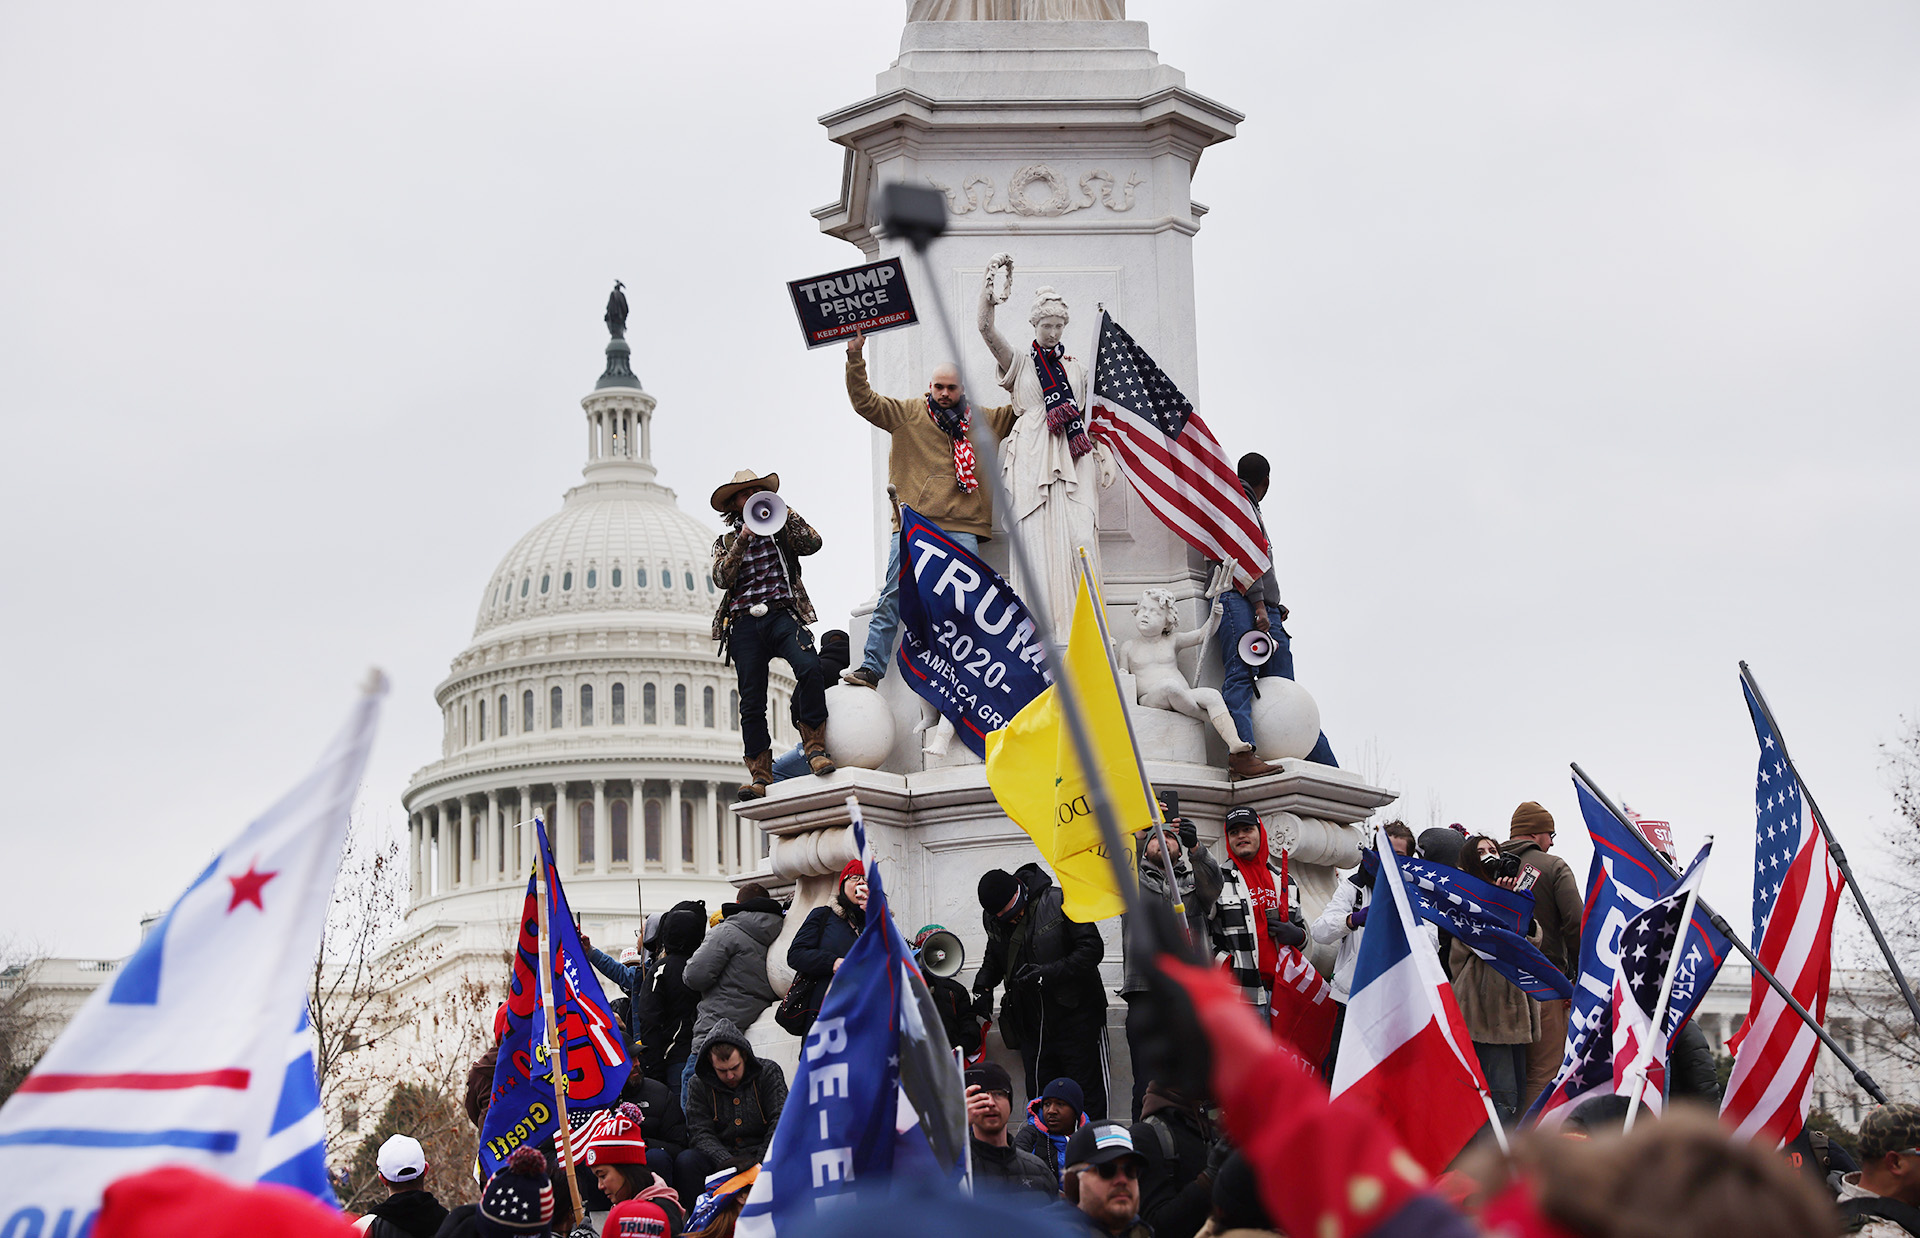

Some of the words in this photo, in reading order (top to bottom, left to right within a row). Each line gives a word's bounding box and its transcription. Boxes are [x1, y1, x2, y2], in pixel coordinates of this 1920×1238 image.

[799, 265, 896, 303] TRUMP
[820, 289, 889, 317] PENCE
[837, 308, 879, 324] 2020
[816, 328, 839, 339] KEEP
[840, 319, 878, 334] AMERICA
[879, 312, 906, 325] GREAT
[914, 539, 1056, 686] TRUM
[917, 649, 978, 710] AMERICA
[592, 1119, 632, 1137] UMP
[619, 1221, 664, 1236] TRUMP
